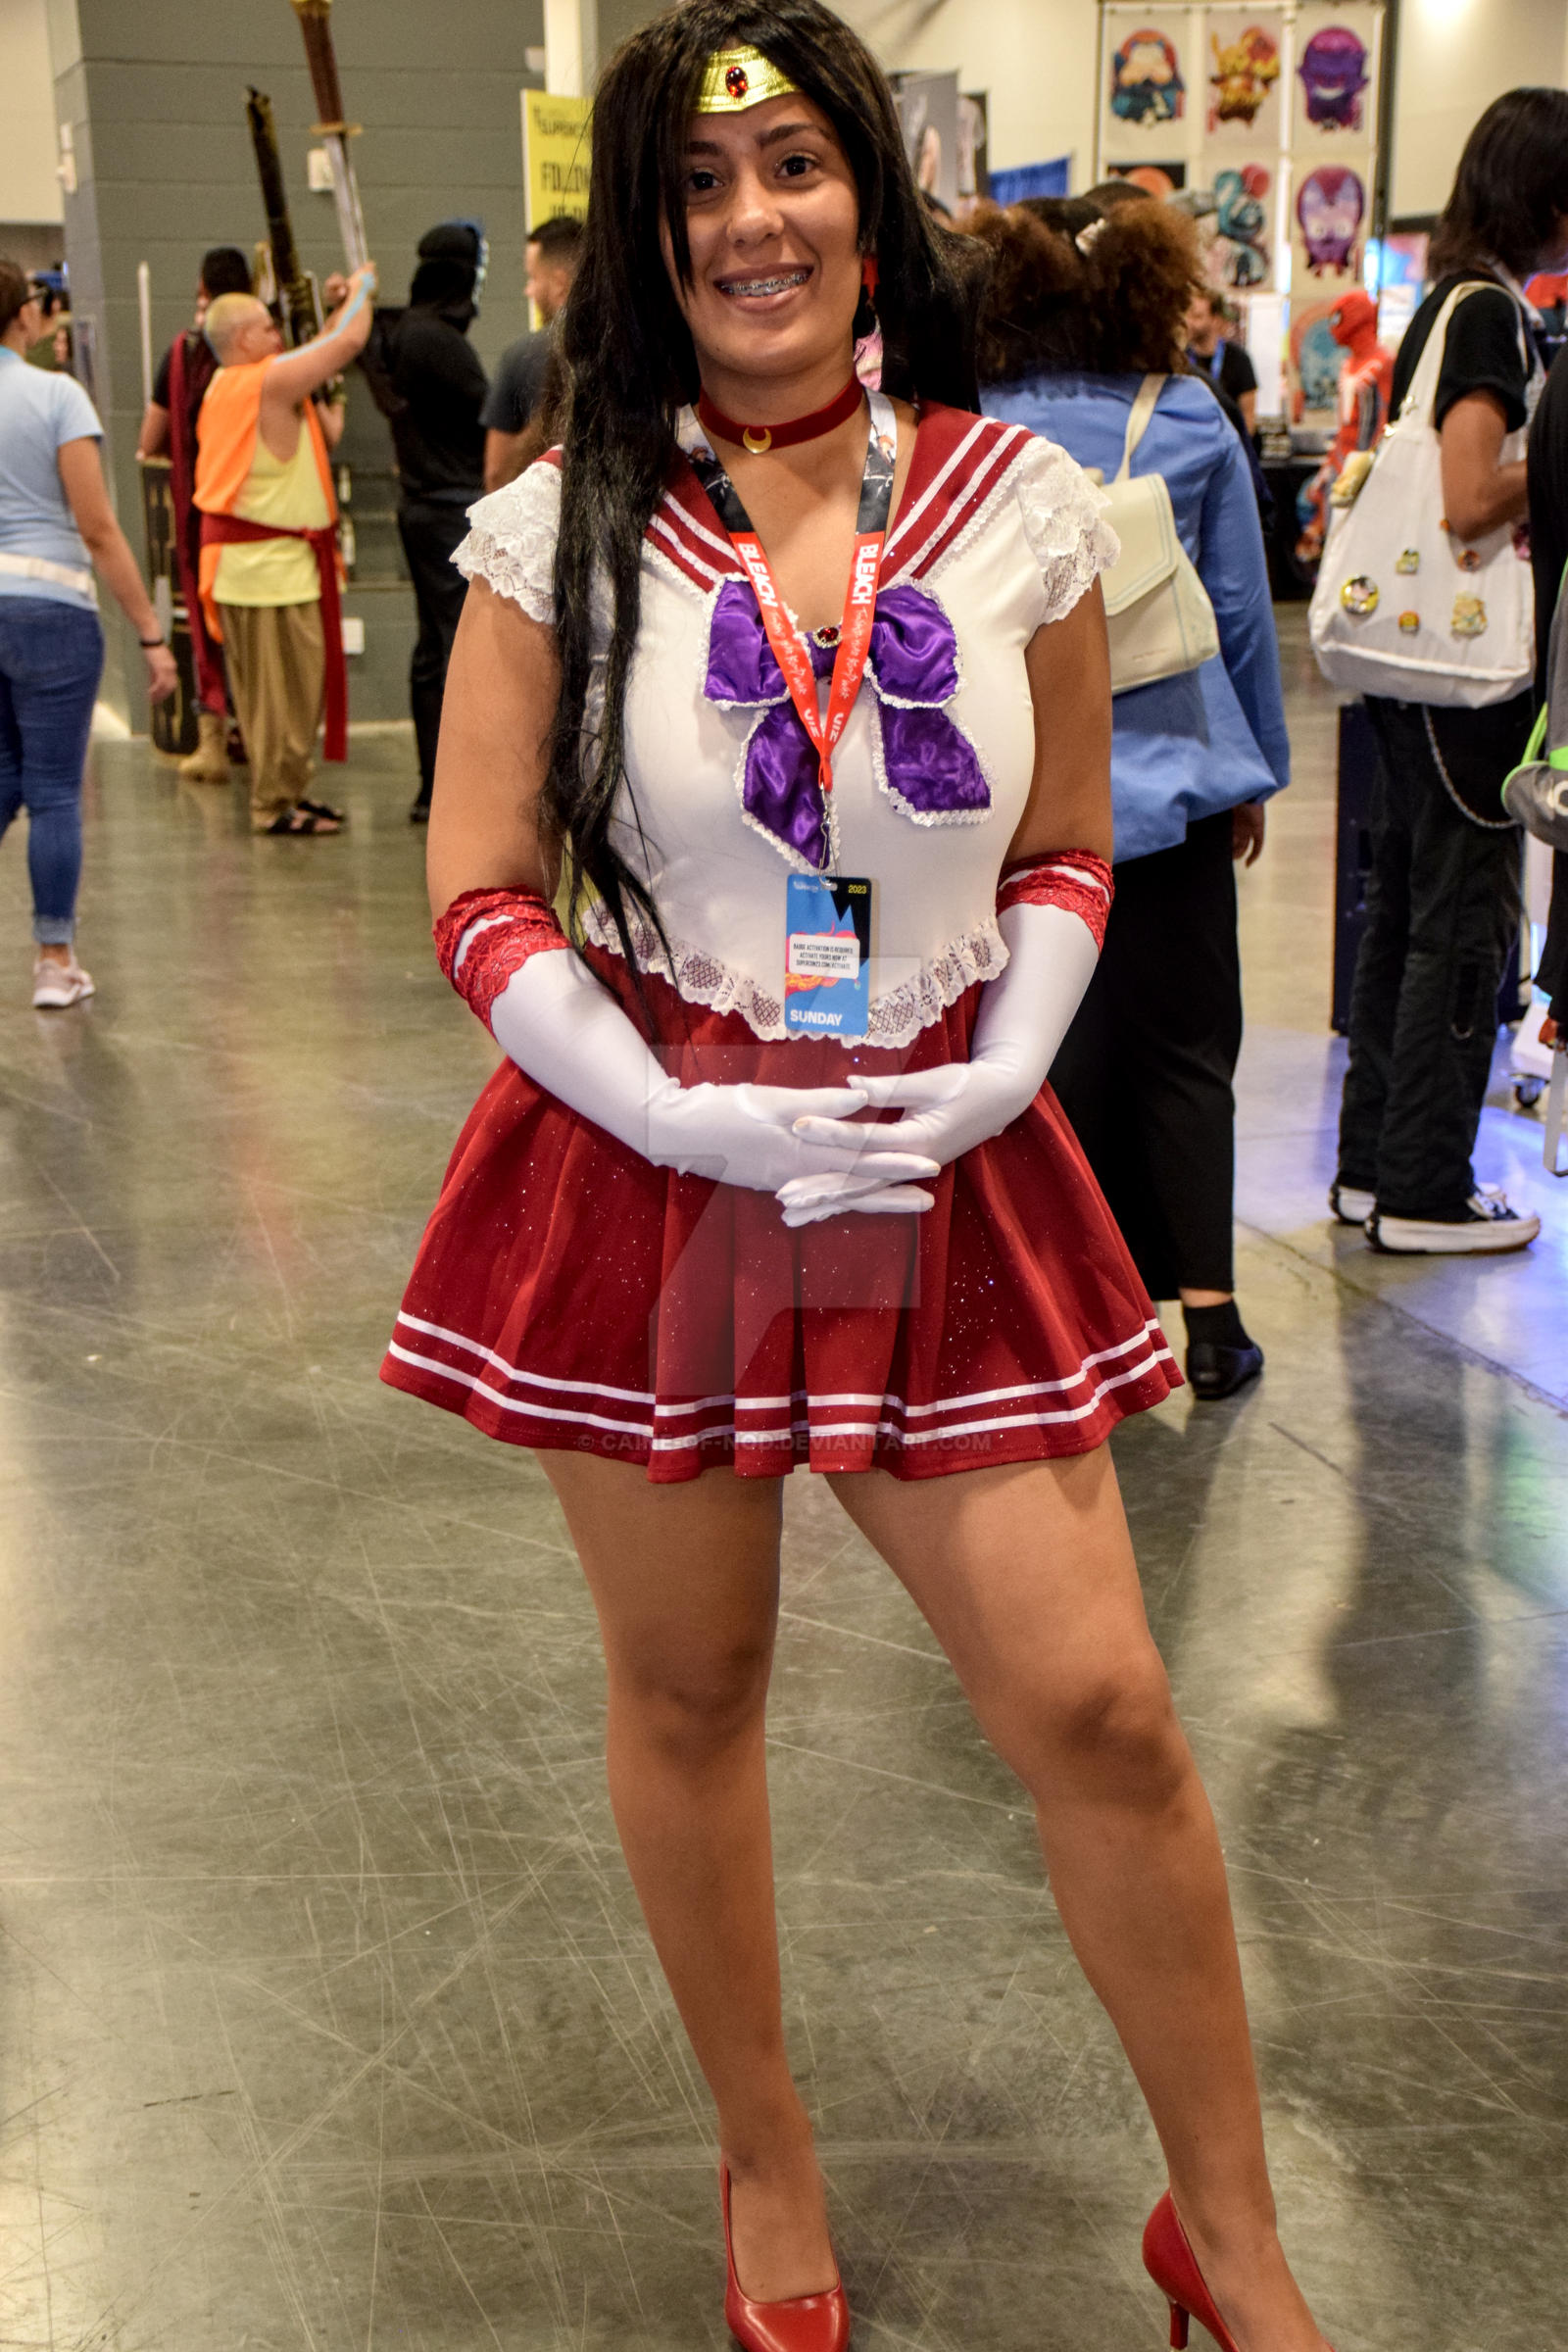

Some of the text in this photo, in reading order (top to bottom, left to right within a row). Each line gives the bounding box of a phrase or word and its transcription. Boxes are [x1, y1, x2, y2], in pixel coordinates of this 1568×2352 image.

[738, 543, 778, 608] BLEACH
[852, 543, 879, 605] BLEACH
[848, 884, 867, 894] 2023
[790, 1009, 843, 1026] SUNDAY
